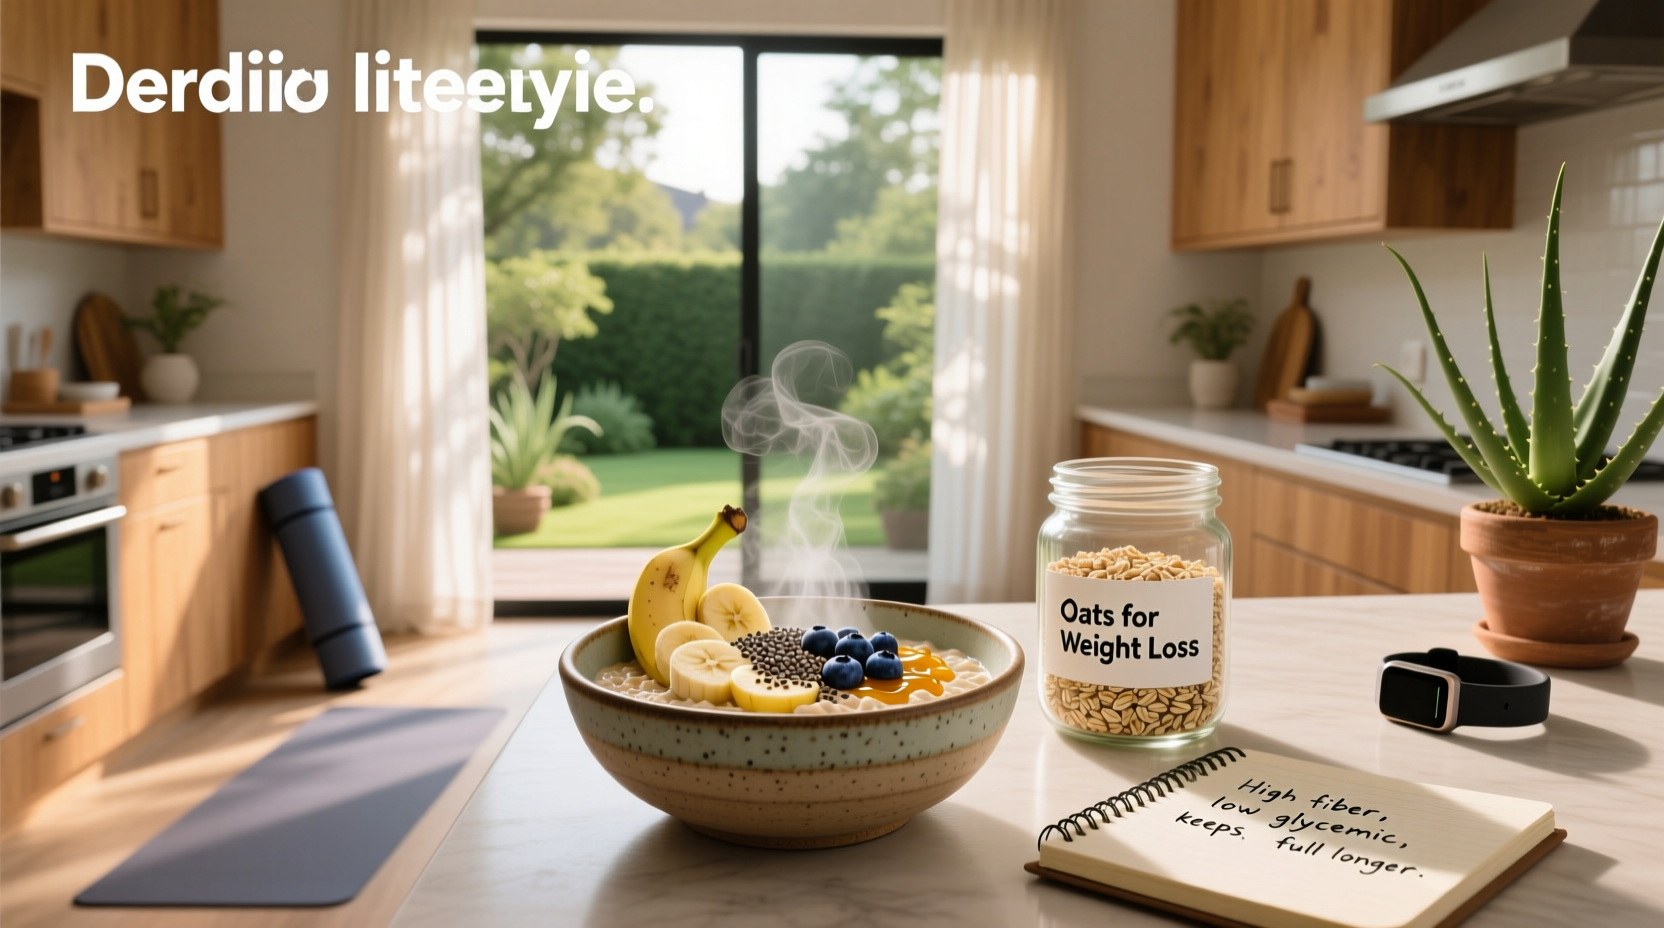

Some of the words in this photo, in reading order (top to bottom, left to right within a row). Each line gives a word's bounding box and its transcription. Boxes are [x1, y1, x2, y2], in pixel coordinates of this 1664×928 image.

[1060, 598, 1115, 627] Oats
[1121, 603, 1160, 628] for
[1060, 630, 1142, 665] Weight
[1148, 636, 1200, 660] Loss
[1237, 778, 1297, 804] High
[1309, 794, 1388, 823] fiber,
[1210, 796, 1262, 816] low
[1268, 812, 1408, 849] glycemic,
[1275, 836, 1326, 857] full
[1330, 846, 1425, 878] longer.
